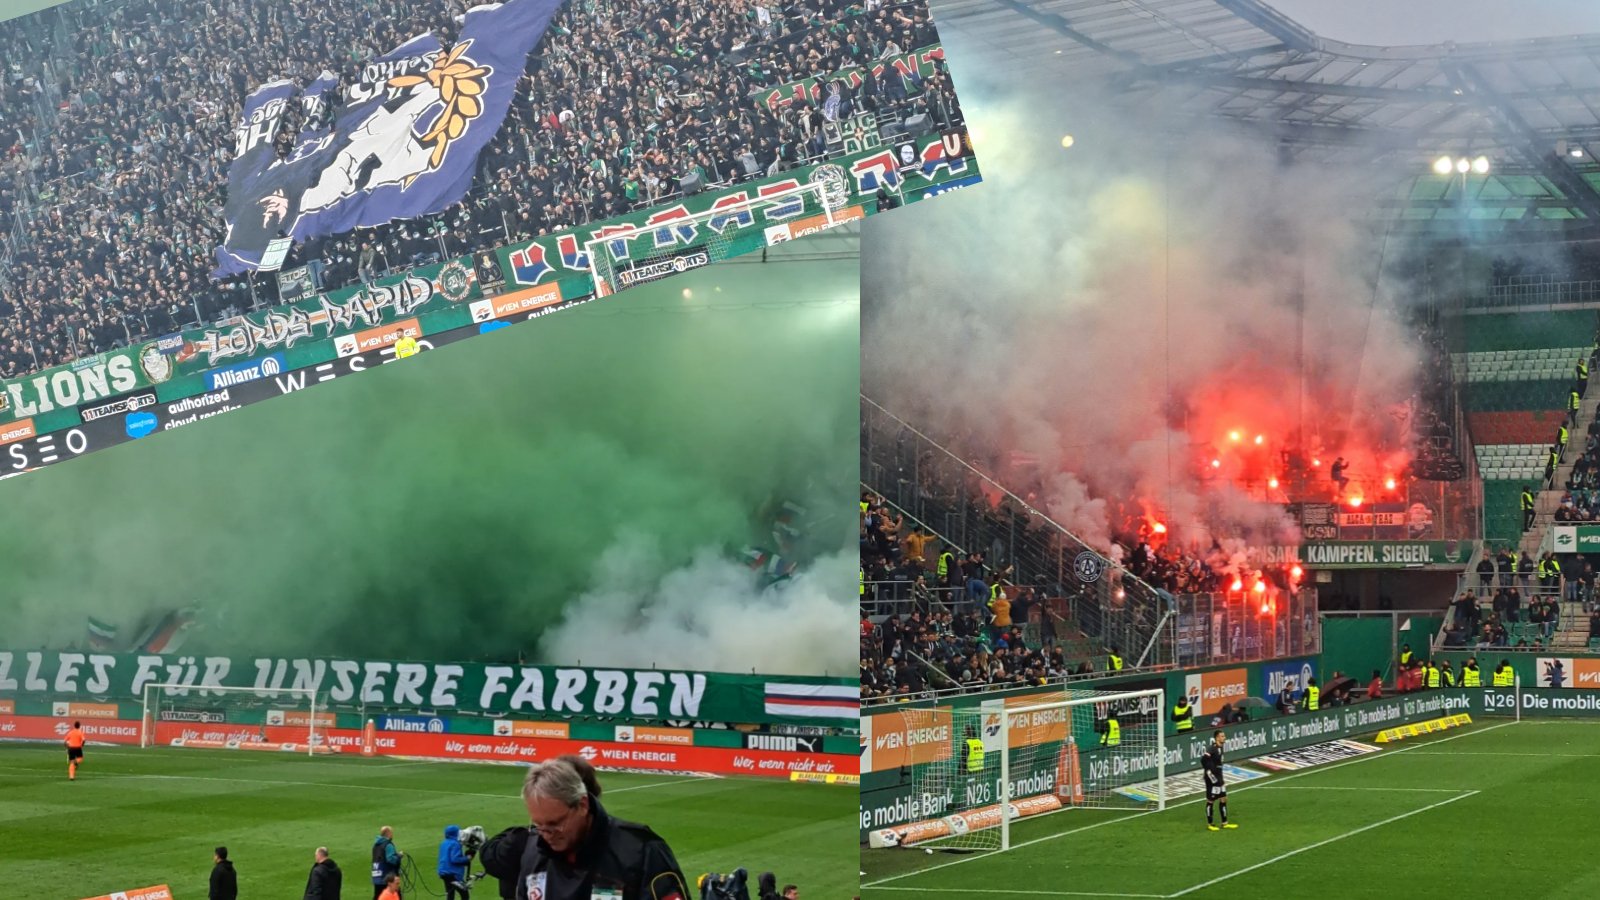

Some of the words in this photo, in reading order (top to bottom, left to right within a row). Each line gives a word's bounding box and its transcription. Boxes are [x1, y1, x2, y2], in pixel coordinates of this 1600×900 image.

[319, 272, 434, 337] RAPID
[496, 302, 519, 313] WIEN
[521, 292, 557, 307] ENERGIE
[361, 337, 381, 348] WIEN
[8, 355, 136, 418] LIONS
[213, 366, 261, 390] Allianz
[168, 389, 230, 414] authorized
[1307, 541, 1378, 563] KÄMPFEN.
[1382, 544, 1434, 563] SIEGEN.
[131, 656, 231, 696] FÜR
[254, 657, 464, 706] UNSERE
[479, 666, 706, 717] FARBEN
[1268, 670, 1300, 695] Allianz
[1417, 700, 1425, 714] Die
[1426, 697, 1441, 712] mobile
[1441, 694, 1470, 709] Bank
[1484, 694, 1515, 708] N26
[1523, 694, 1549, 709] Die
[1552, 694, 1600, 710] mobile
[384, 718, 426, 732] Allianz
[1032, 707, 1067, 726] ENERGIE
[1345, 711, 1357, 728] N26
[1358, 710, 1367, 725] Die
[1368, 707, 1387, 723] mobile
[1387, 704, 1400, 720] Bank
[99, 727, 137, 736] ENERGIE
[876, 733, 904, 749] WIEN
[907, 725, 948, 745] ENERGIE
[1272, 726, 1287, 743] N26
[1289, 723, 1300, 739] Die
[1302, 718, 1322, 737] mobile
[1324, 714, 1340, 732] Bank
[328, 736, 353, 745] WIEN
[445, 740, 464, 754] Wer,
[468, 743, 491, 753] wenn
[494, 741, 519, 755] nicht
[520, 744, 537, 756] wir.
[748, 735, 797, 752] PUMA
[1190, 741, 1206, 760] N26
[1249, 729, 1266, 748] Bank
[602, 750, 629, 760] WIEN
[632, 751, 677, 763] ENERGIE
[733, 755, 754, 770] Wer,
[759, 759, 784, 769] wenn
[787, 756, 815, 771] nicht
[816, 759, 834, 772] wir.
[1089, 759, 1109, 780] N26
[1113, 755, 1129, 776] Die
[1131, 748, 1159, 773] mobile
[1162, 743, 1183, 765] Bank
[875, 794, 919, 822] mobile
[922, 788, 954, 814] Bank
[967, 783, 991, 805] N26
[1017, 770, 1053, 796] mobile
